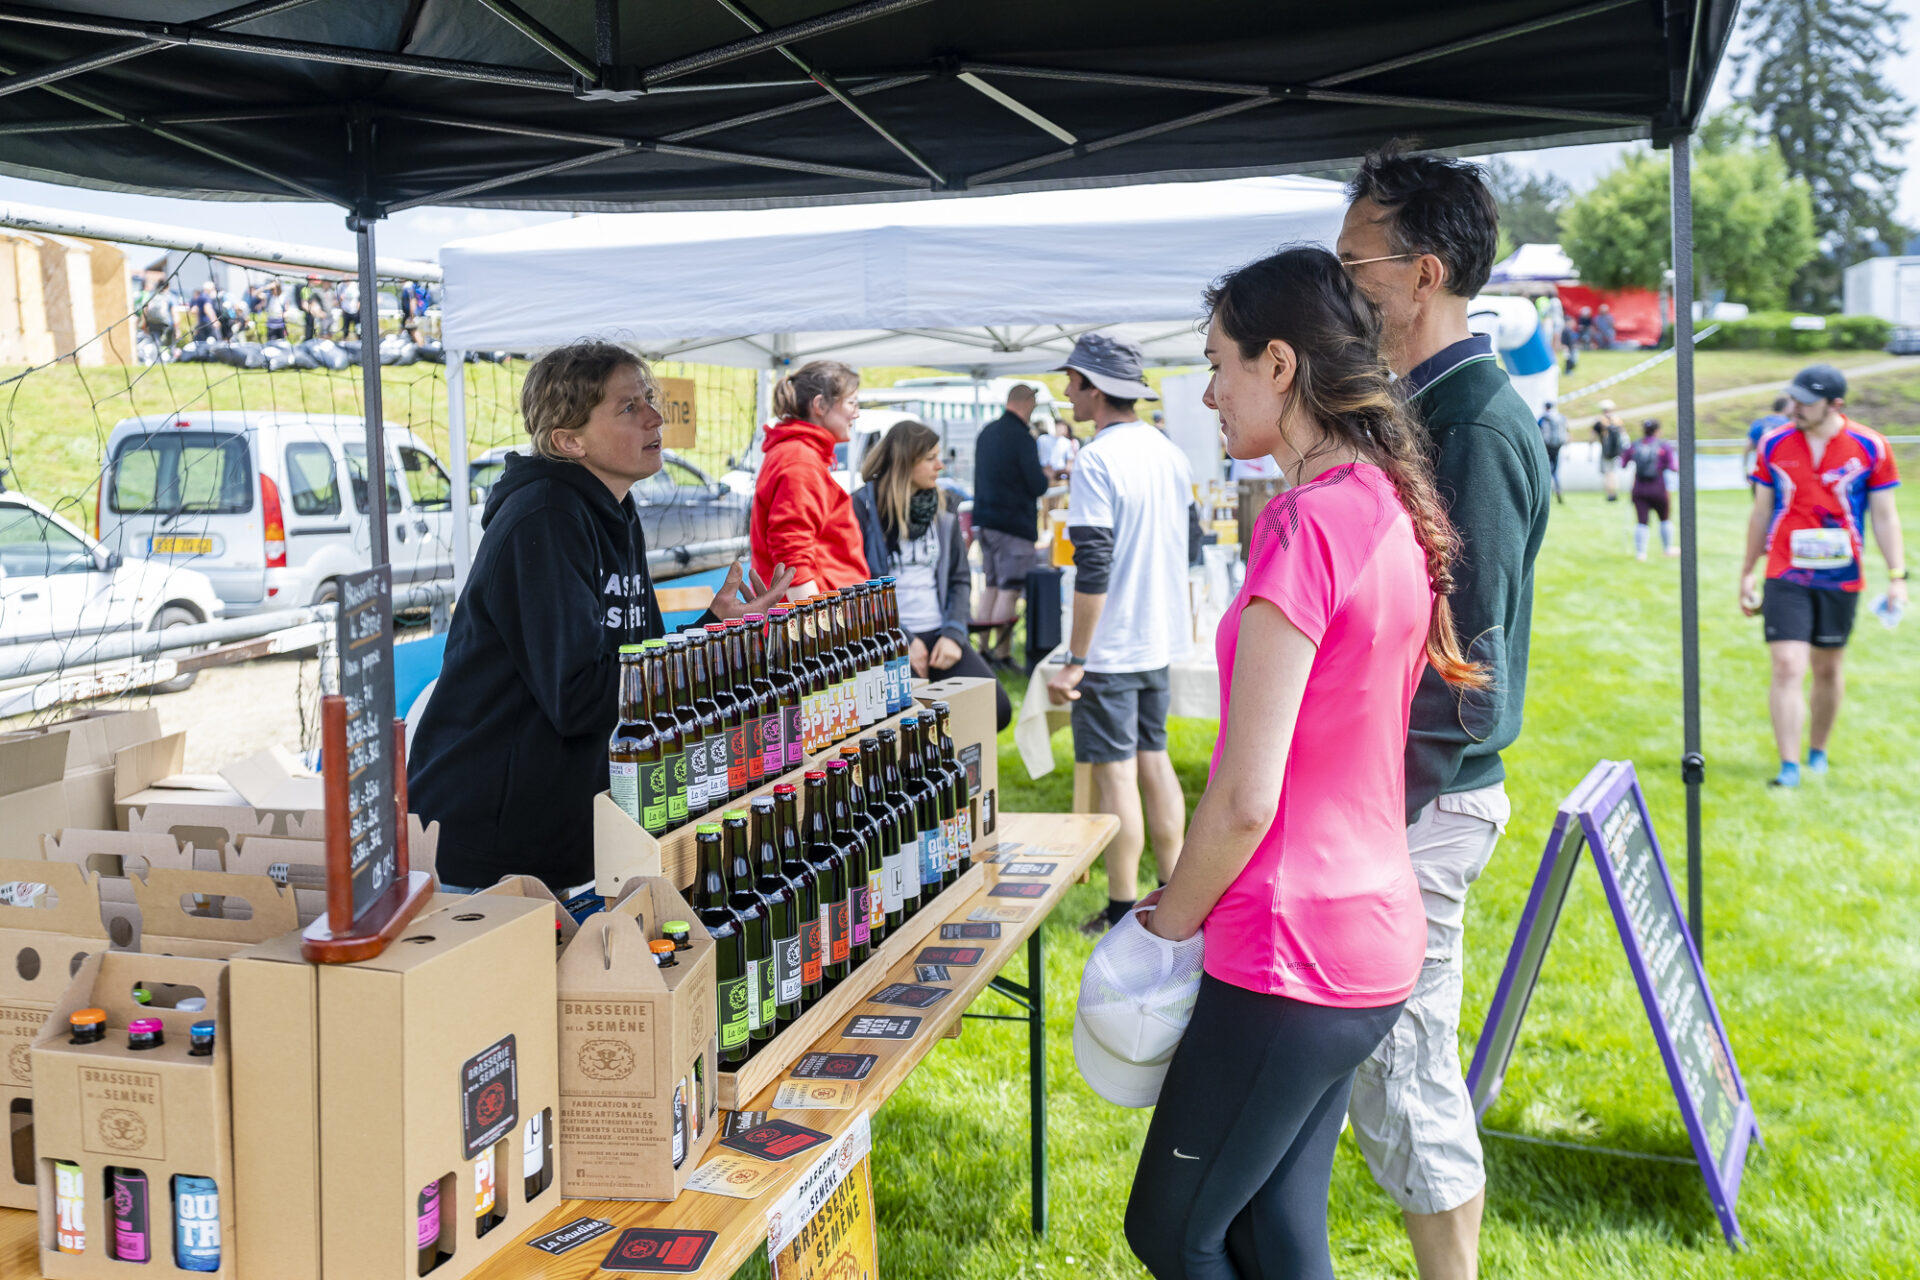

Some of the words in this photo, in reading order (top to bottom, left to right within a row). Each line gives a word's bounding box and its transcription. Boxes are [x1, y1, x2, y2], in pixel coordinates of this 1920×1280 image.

[564, 1004, 647, 1016] BRASSERIE
[586, 1018, 646, 1032] SEMÈNE
[468, 1046, 510, 1080] BRASSERIE
[85, 1071, 155, 1088] BRASSERIE
[104, 1086, 155, 1104] SEMÈNE
[560, 1109, 592, 1117] BIÈRES
[595, 1111, 654, 1119] ARTISANALES
[799, 1148, 838, 1199] BRASSERIE
[810, 1169, 837, 1211] SEMÈNE
[179, 1193, 219, 1220] QU
[792, 1169, 857, 1263] BRASSERIE
[539, 1240, 561, 1251] La
[556, 1219, 604, 1244] Gaudine
[816, 1194, 860, 1268] SEMÈNE
